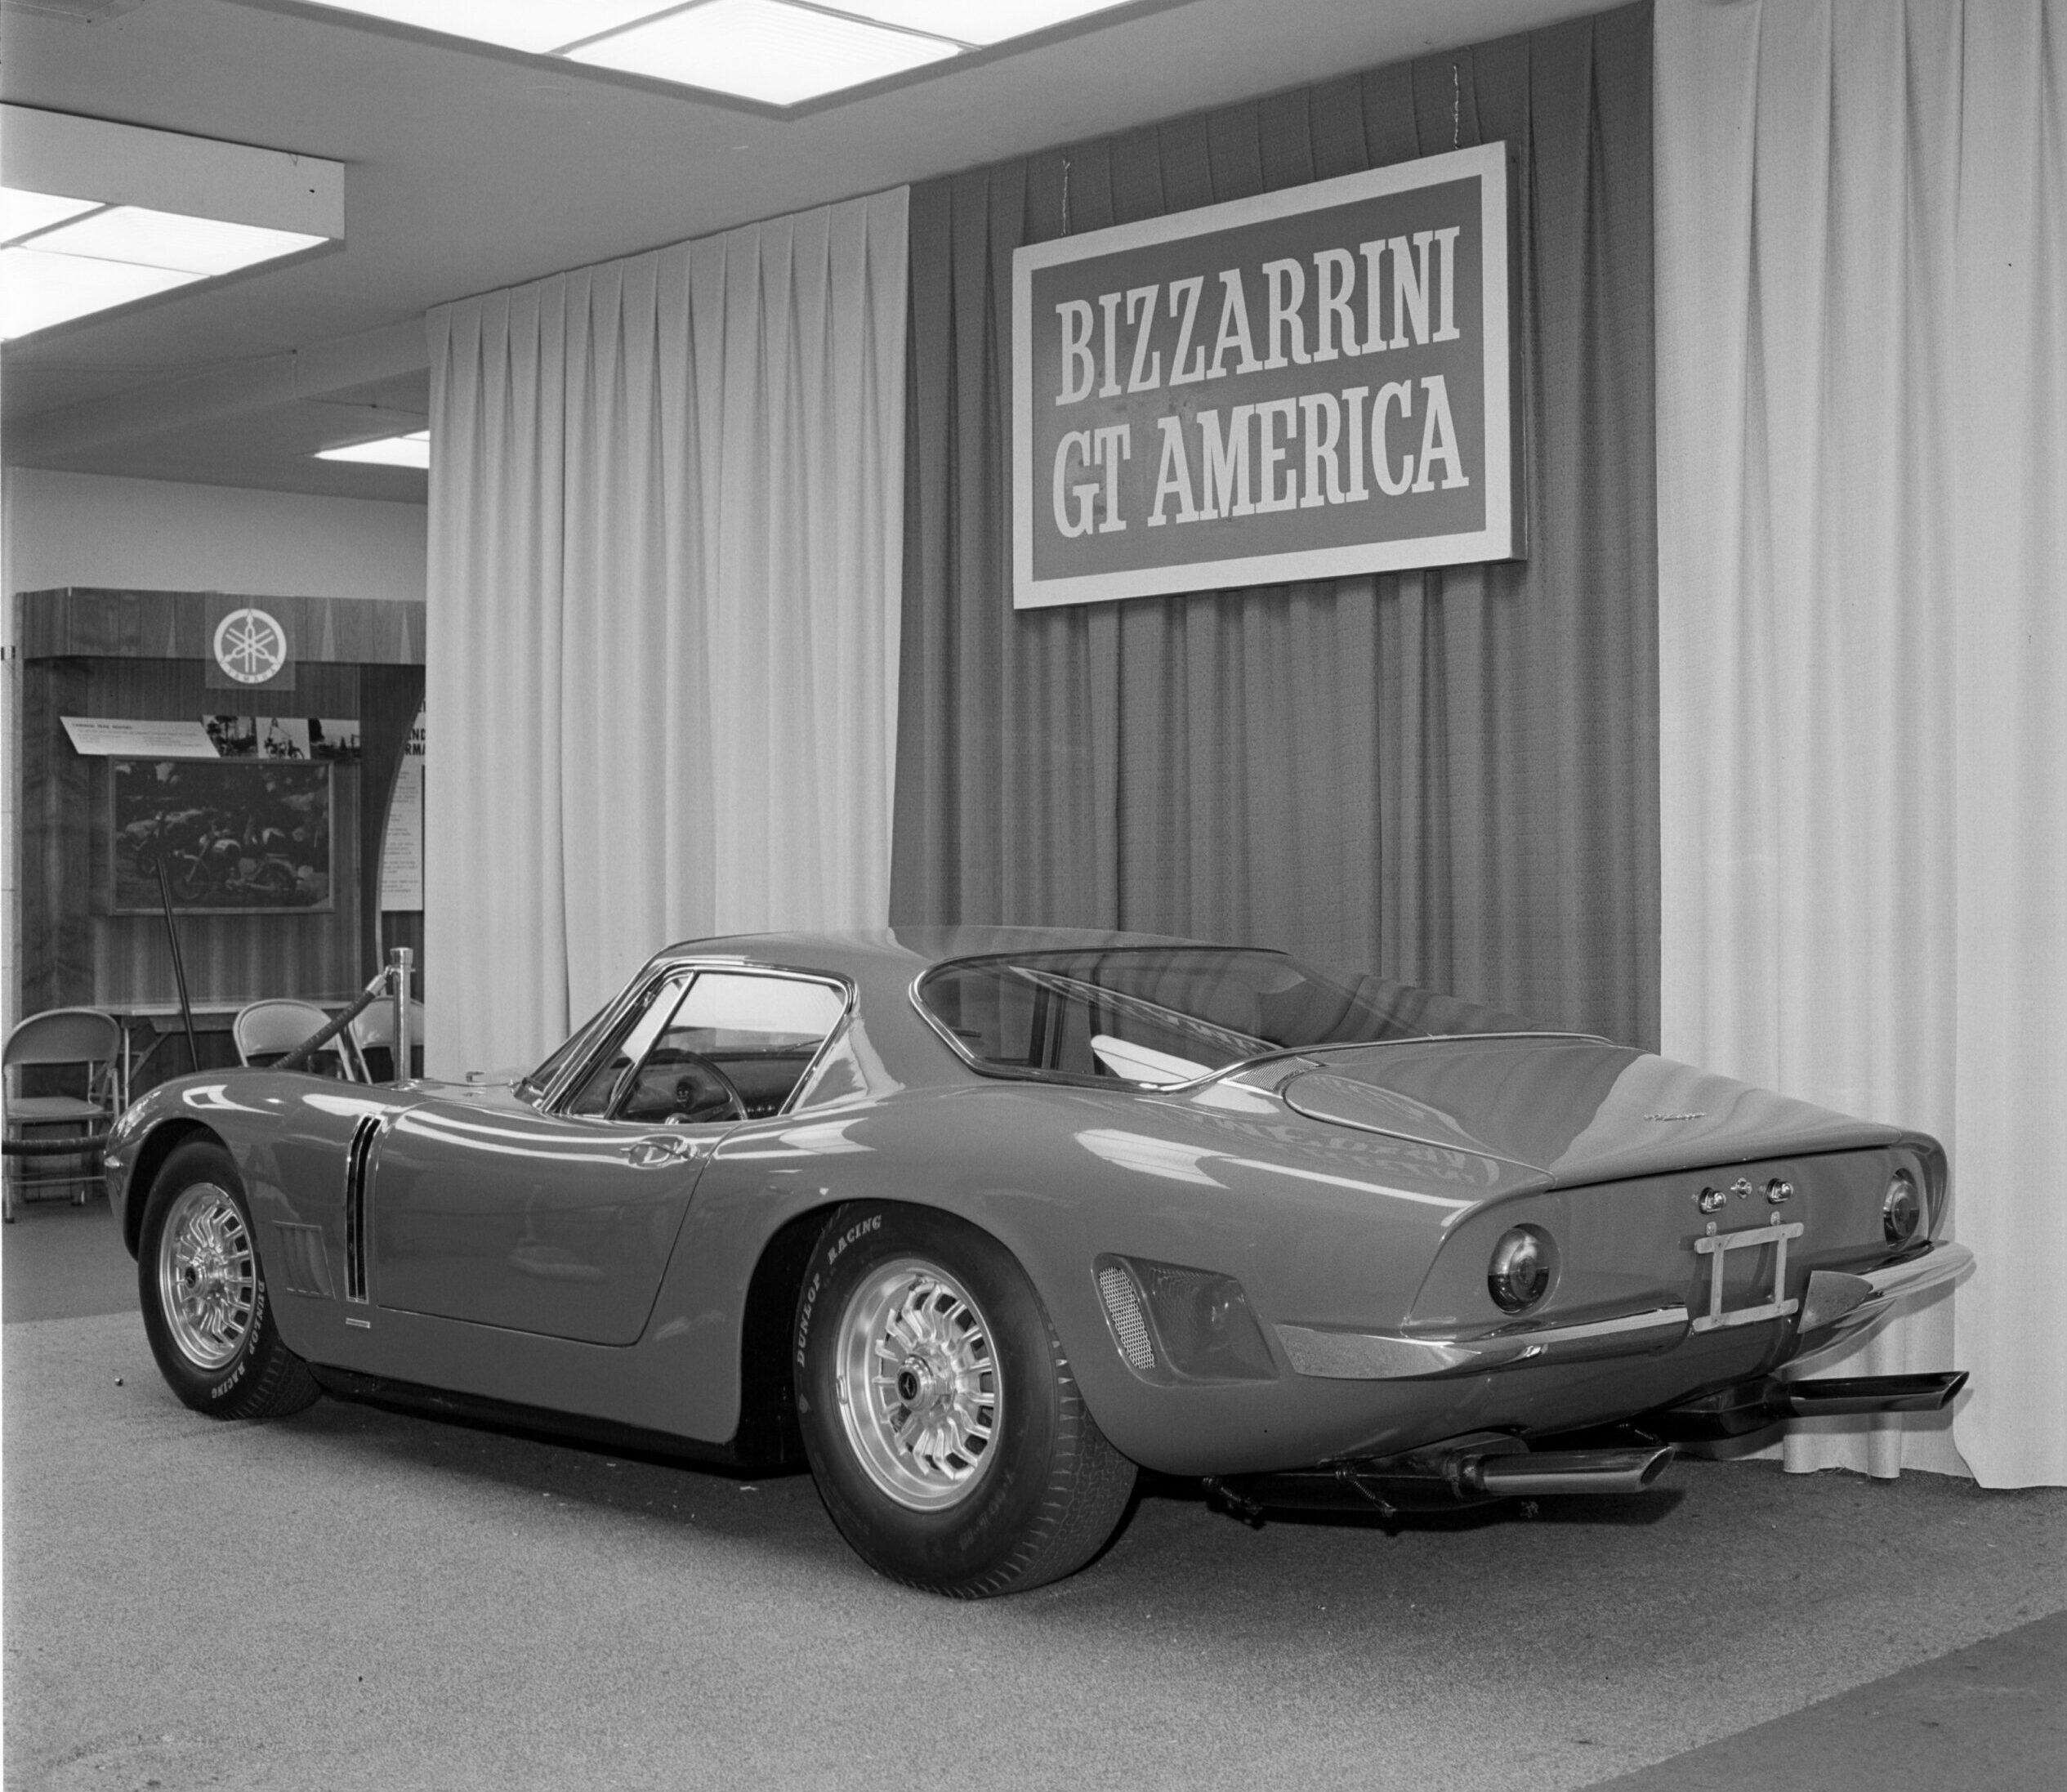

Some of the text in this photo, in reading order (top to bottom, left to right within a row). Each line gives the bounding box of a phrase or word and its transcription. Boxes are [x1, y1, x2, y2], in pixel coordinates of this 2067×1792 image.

[1056, 226, 1460, 406] BIZZARRINI
[1053, 374, 1469, 538] GT AMERICA
[212, 1280, 265, 1399] DUNLOP RACING
[797, 1215, 882, 1367] DUNLOP RACING
